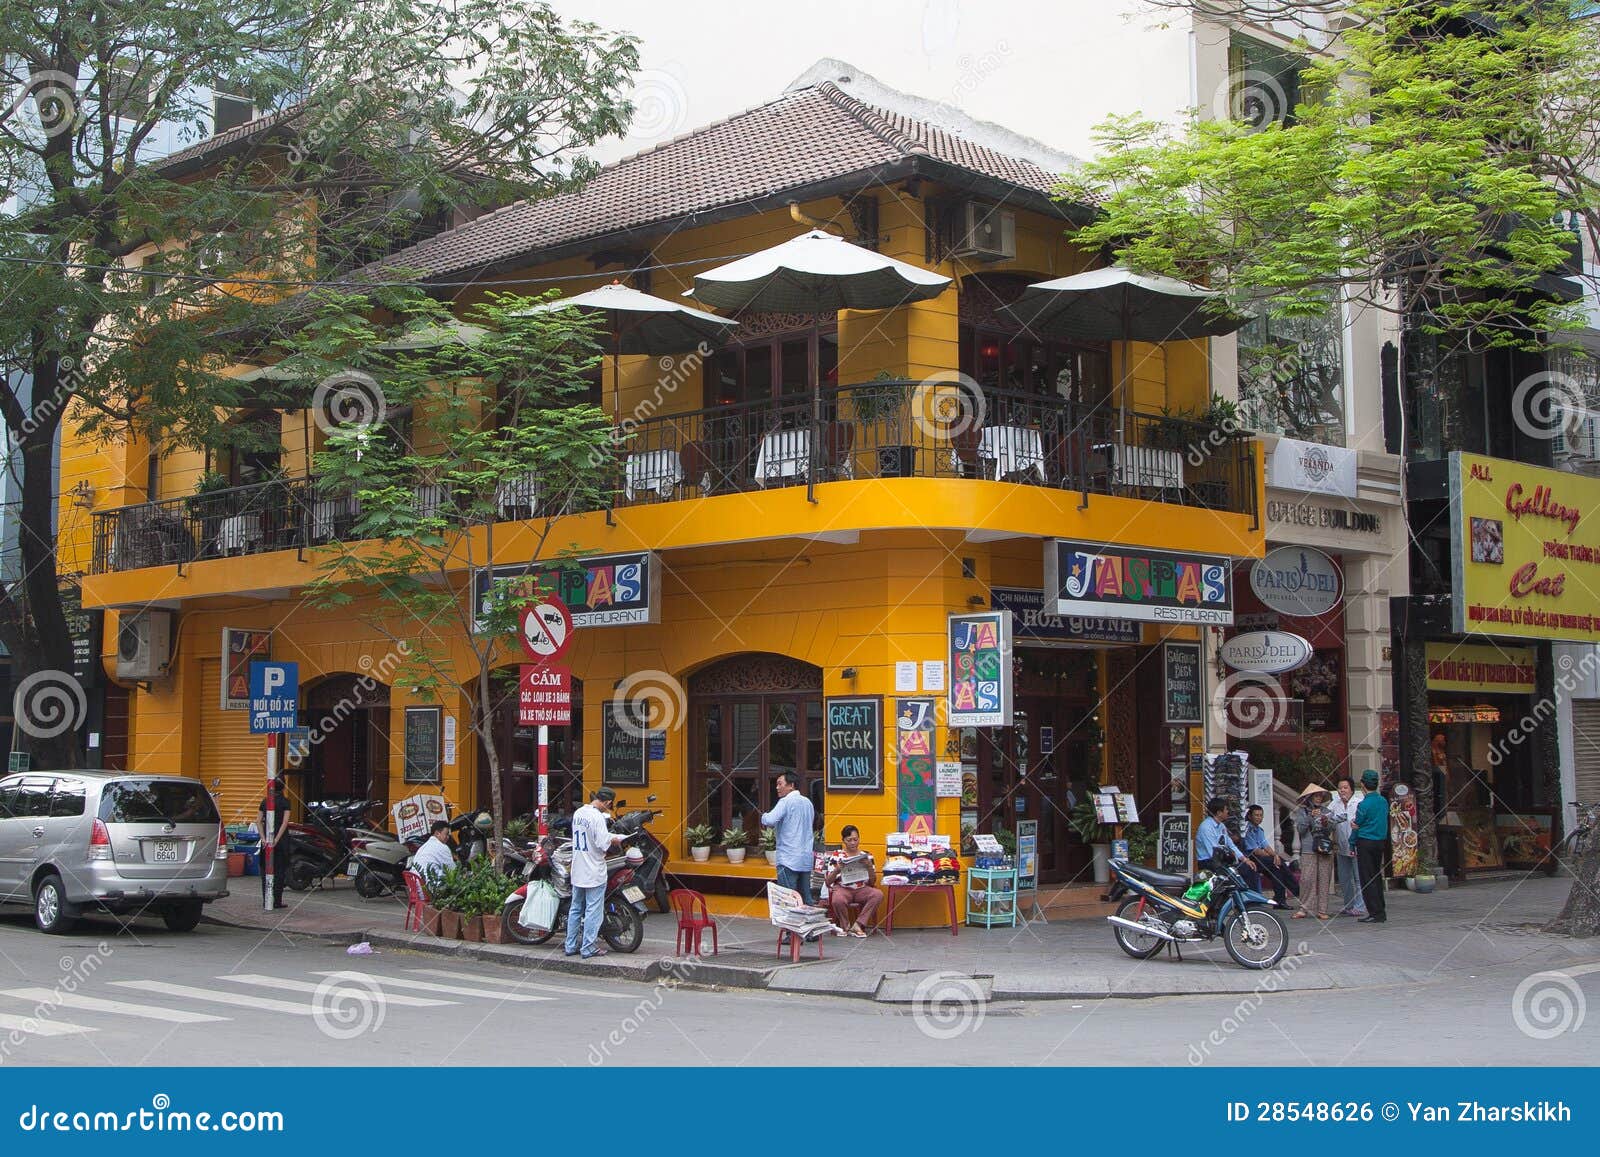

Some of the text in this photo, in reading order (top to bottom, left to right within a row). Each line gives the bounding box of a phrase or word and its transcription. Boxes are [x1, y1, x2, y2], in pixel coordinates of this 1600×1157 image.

[1470, 463, 1493, 482] ALL
[1506, 482, 1581, 535] Gallery
[1320, 507, 1382, 534] BUILDING
[1065, 551, 1225, 605] JASPAS
[1256, 569, 1337, 593] PARIS DELI
[1510, 561, 1566, 598] Cat
[572, 610, 646, 626] ESTAURANT
[1153, 606, 1230, 624] RESTAURANT
[1229, 646, 1296, 658] PARIS DELI
[264, 667, 285, 696] P
[530, 667, 562, 686] CẤM
[283, 699, 295, 711] XE
[521, 688, 532, 703] CÁC
[545, 691, 552, 703] XE
[556, 689, 570, 703] BÁNH
[265, 717, 280, 729] THU
[281, 713, 294, 729] PHÍ
[528, 709, 535, 721] XE
[553, 710, 557, 721] 4
[557, 707, 570, 721] BÁNH
[830, 705, 871, 725] GREAT
[951, 714, 1000, 725] RESTAURANT
[831, 730, 873, 750] STEAK
[832, 756, 869, 778] MENU
[574, 830, 588, 851] 11
[1163, 839, 1188, 855] STEAK
[156, 851, 176, 860] 6640
[1164, 854, 1185, 866] MENU
